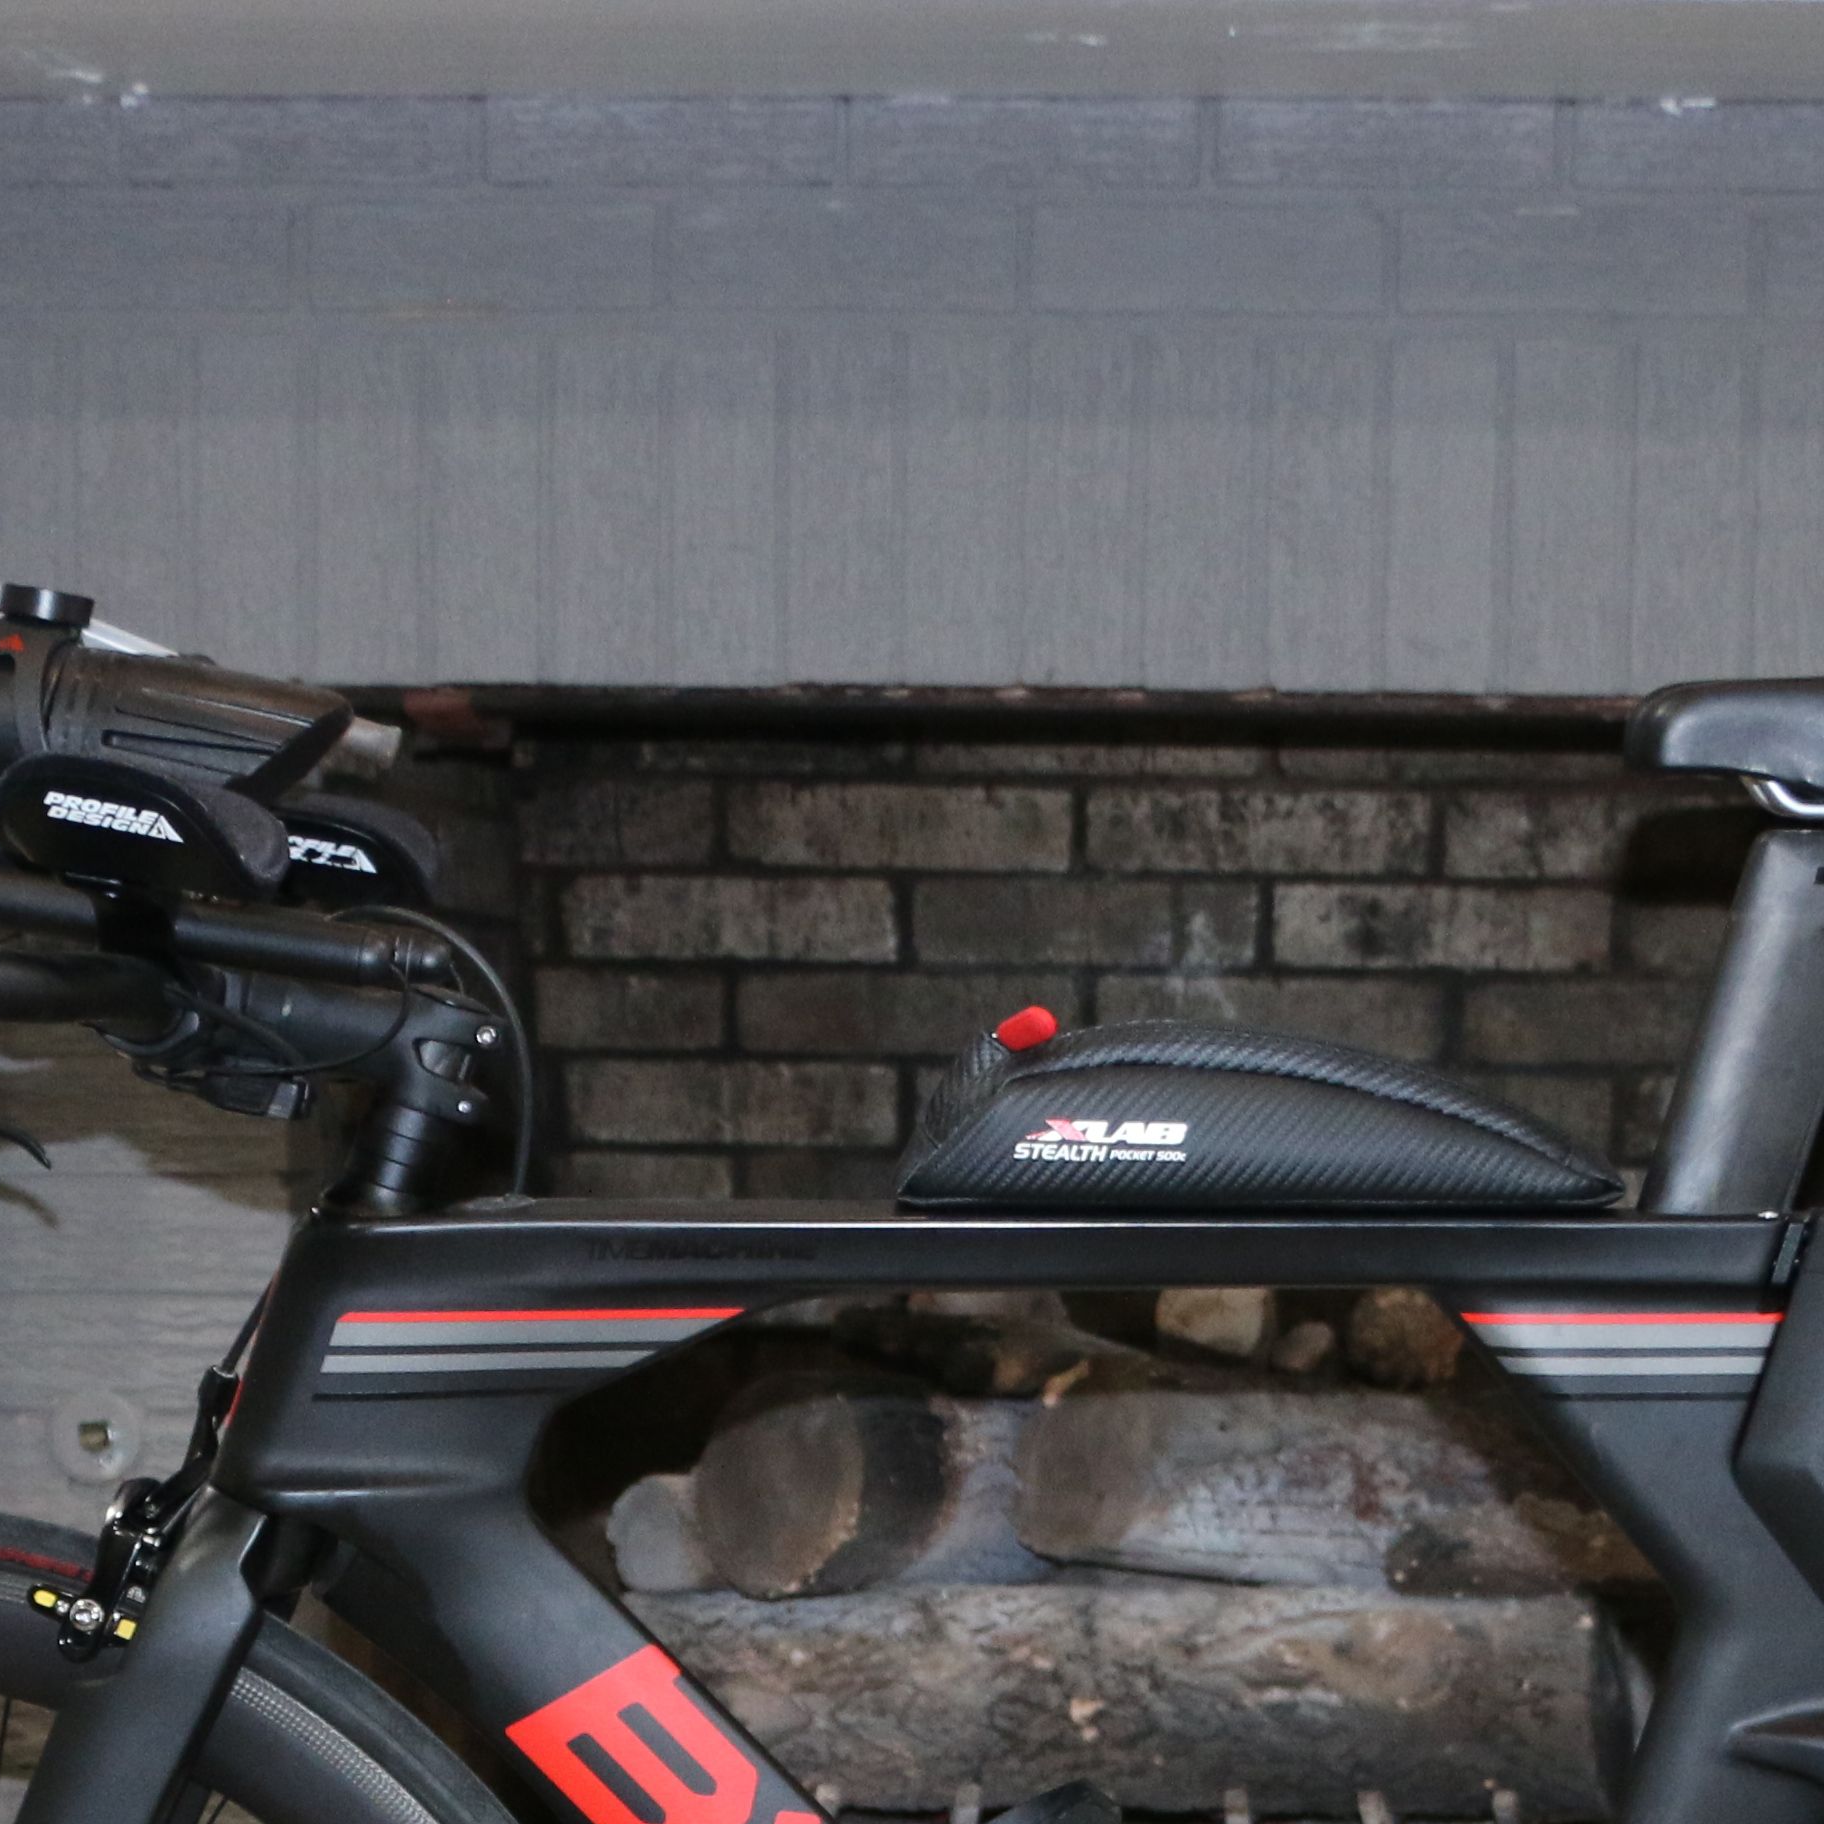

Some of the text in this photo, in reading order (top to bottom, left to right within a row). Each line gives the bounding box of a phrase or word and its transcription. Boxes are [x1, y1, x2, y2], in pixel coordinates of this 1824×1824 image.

[42, 790, 160, 824] PROFILE
[46, 805, 153, 837] DESIGN
[1026, 1117, 1188, 1145] XLAB
[1013, 1142, 1109, 1162] STEALTH
[1109, 1149, 1155, 1161] POCKET
